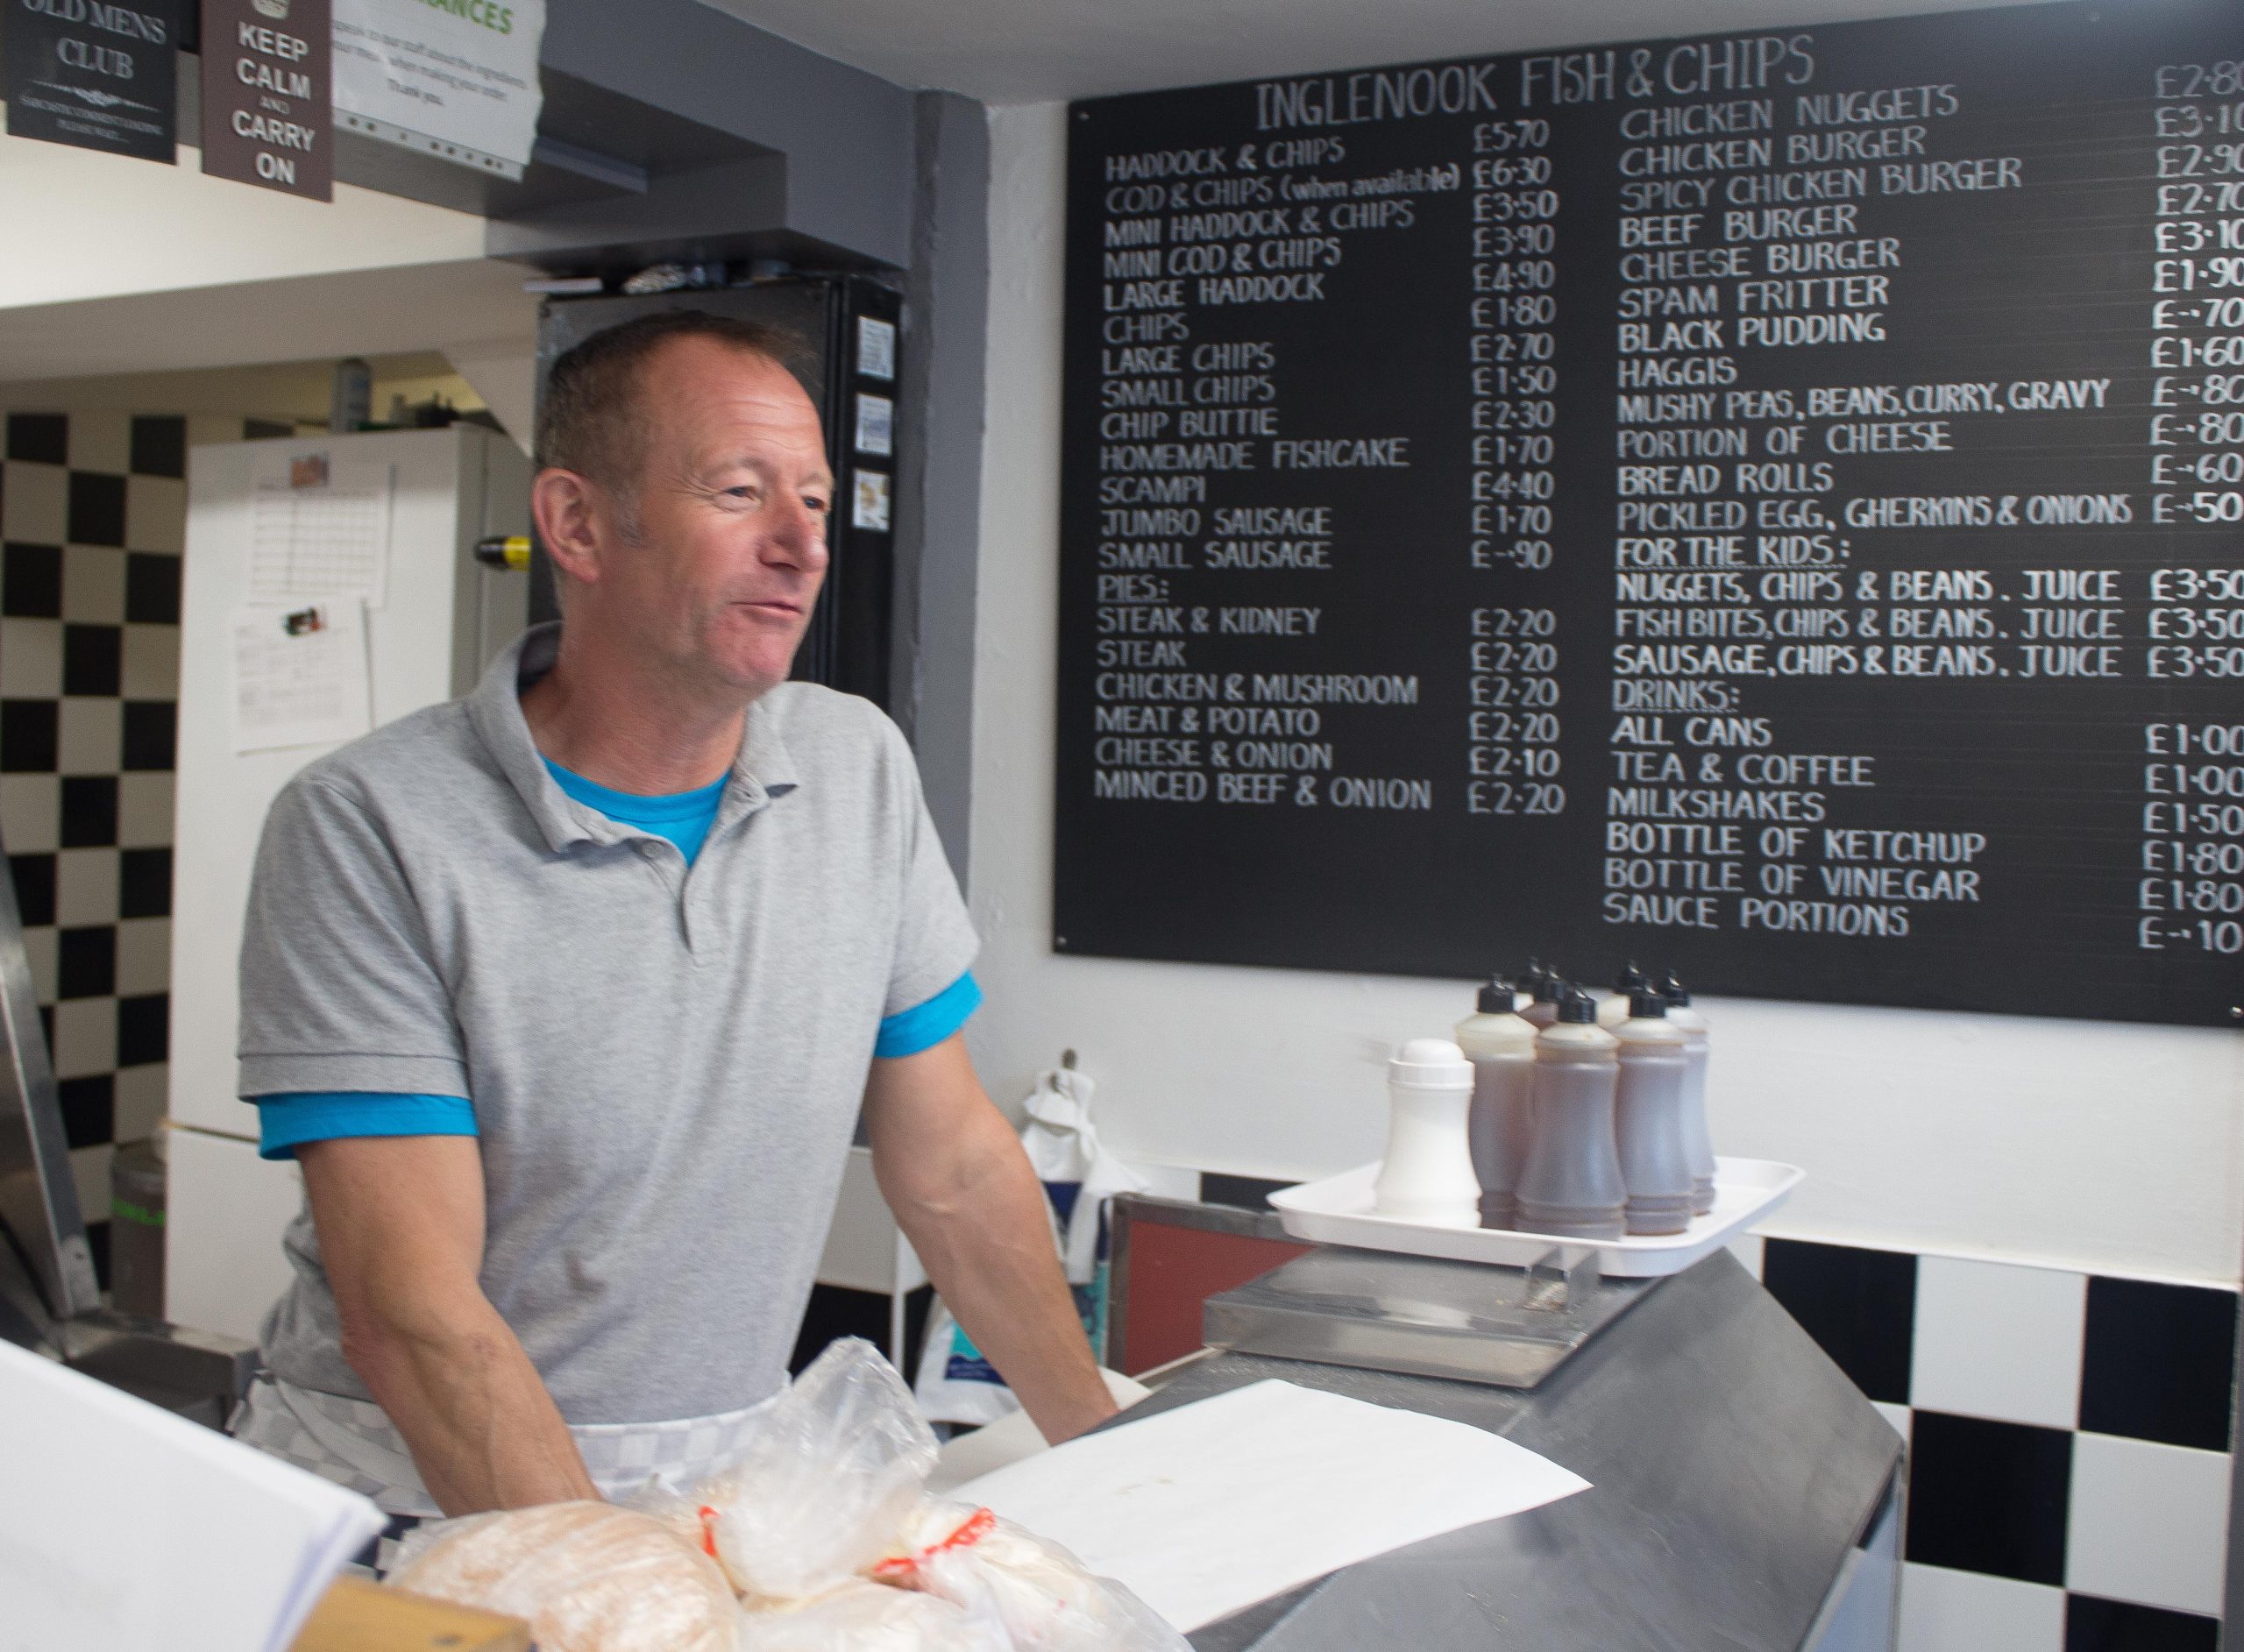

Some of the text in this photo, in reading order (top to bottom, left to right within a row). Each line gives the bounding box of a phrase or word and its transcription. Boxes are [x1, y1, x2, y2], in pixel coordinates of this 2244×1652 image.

[89, 1, 167, 45] MENS
[238, 21, 309, 62] KEEP
[56, 38, 133, 79] CLUB
[236, 58, 311, 100] CALM
[1259, 36, 1813, 130] INGLENOOK FISH & CHIPS
[1621, 84, 1958, 139] CHICKEN NUGGETS
[231, 110, 315, 152] CARRY
[256, 152, 295, 185] ON
[1106, 137, 1345, 181] HADDOCK & CHIPS
[1619, 125, 1926, 176] CHICKEN BURGER
[1106, 162, 1460, 213] COD & CHIPS (when available)
[1621, 157, 2021, 211] SPICY CHICKEN BURGER
[1105, 200, 1414, 246] MINI HADDOCK & CHIPS
[1619, 204, 1857, 248] BEEF BURGER
[1105, 237, 1341, 277] MINI COD & CHIPS
[1620, 238, 1900, 282] CHEESE BURGER
[1104, 273, 1324, 311] LARGE HADDOCK
[1617, 274, 1889, 319] SPAM FRITTER
[1104, 315, 1188, 344] CHIPS
[1618, 312, 1886, 353] BLACK PUDDING
[1103, 342, 1275, 375] LARGE CHIPS
[1617, 357, 1737, 388] HAGGIS
[1103, 375, 1275, 408] SMALL CHIPS
[1617, 393, 1716, 423] MUSHY
[2007, 378, 2111, 410] GRAVY
[1101, 408, 1277, 439] CHIP BUTTIE
[1617, 421, 1954, 458] PORTION OF CHEESE
[1101, 437, 1410, 471] HOMEMADE FISHCAKE
[1100, 477, 1204, 504] SCAMPI
[1617, 462, 1834, 496] BREAD ROLLS
[1102, 507, 1332, 535] JUMBO SAUSAGE
[1617, 501, 1746, 531] PICKLED
[1844, 495, 1993, 528] GHERKINS
[1995, 495, 2020, 526] &
[2026, 493, 2133, 525] ONIONS
[1100, 541, 1331, 569] SMALL SAUSAGE
[1615, 537, 1676, 571] FOR
[1685, 536, 1743, 568] THE
[1761, 571, 1843, 601] CHIPS
[1856, 571, 1879, 601] &
[2022, 569, 2122, 602] JUICE
[1098, 606, 1321, 635] STEAK & KIDNEY
[1775, 609, 1849, 637] CHIPS
[1858, 608, 1880, 637] &
[2020, 607, 2125, 640] JUICE
[1097, 640, 1185, 667] STEAK
[1777, 644, 1859, 676] CHIPS
[1863, 645, 1888, 676] &
[2018, 644, 2123, 678] JUICE
[1097, 672, 1418, 705] CHICKEN & MUSHROOM
[1096, 705, 1320, 735] MEAT & POTATO
[1610, 715, 1772, 748] ALL CANS
[1096, 737, 1332, 769] CHEESE & ONION
[1611, 750, 1876, 786] TEA & COFFEE
[1095, 769, 1431, 810] MINCED BEEF & ONION
[1608, 787, 1826, 822] MILKSHAKES
[1606, 820, 1986, 863] BOTTLE OF KETCHUP
[1604, 857, 1980, 902] BOTTLE OF VINEGAR
[1603, 892, 1909, 937] SAUCE PORTIONS
